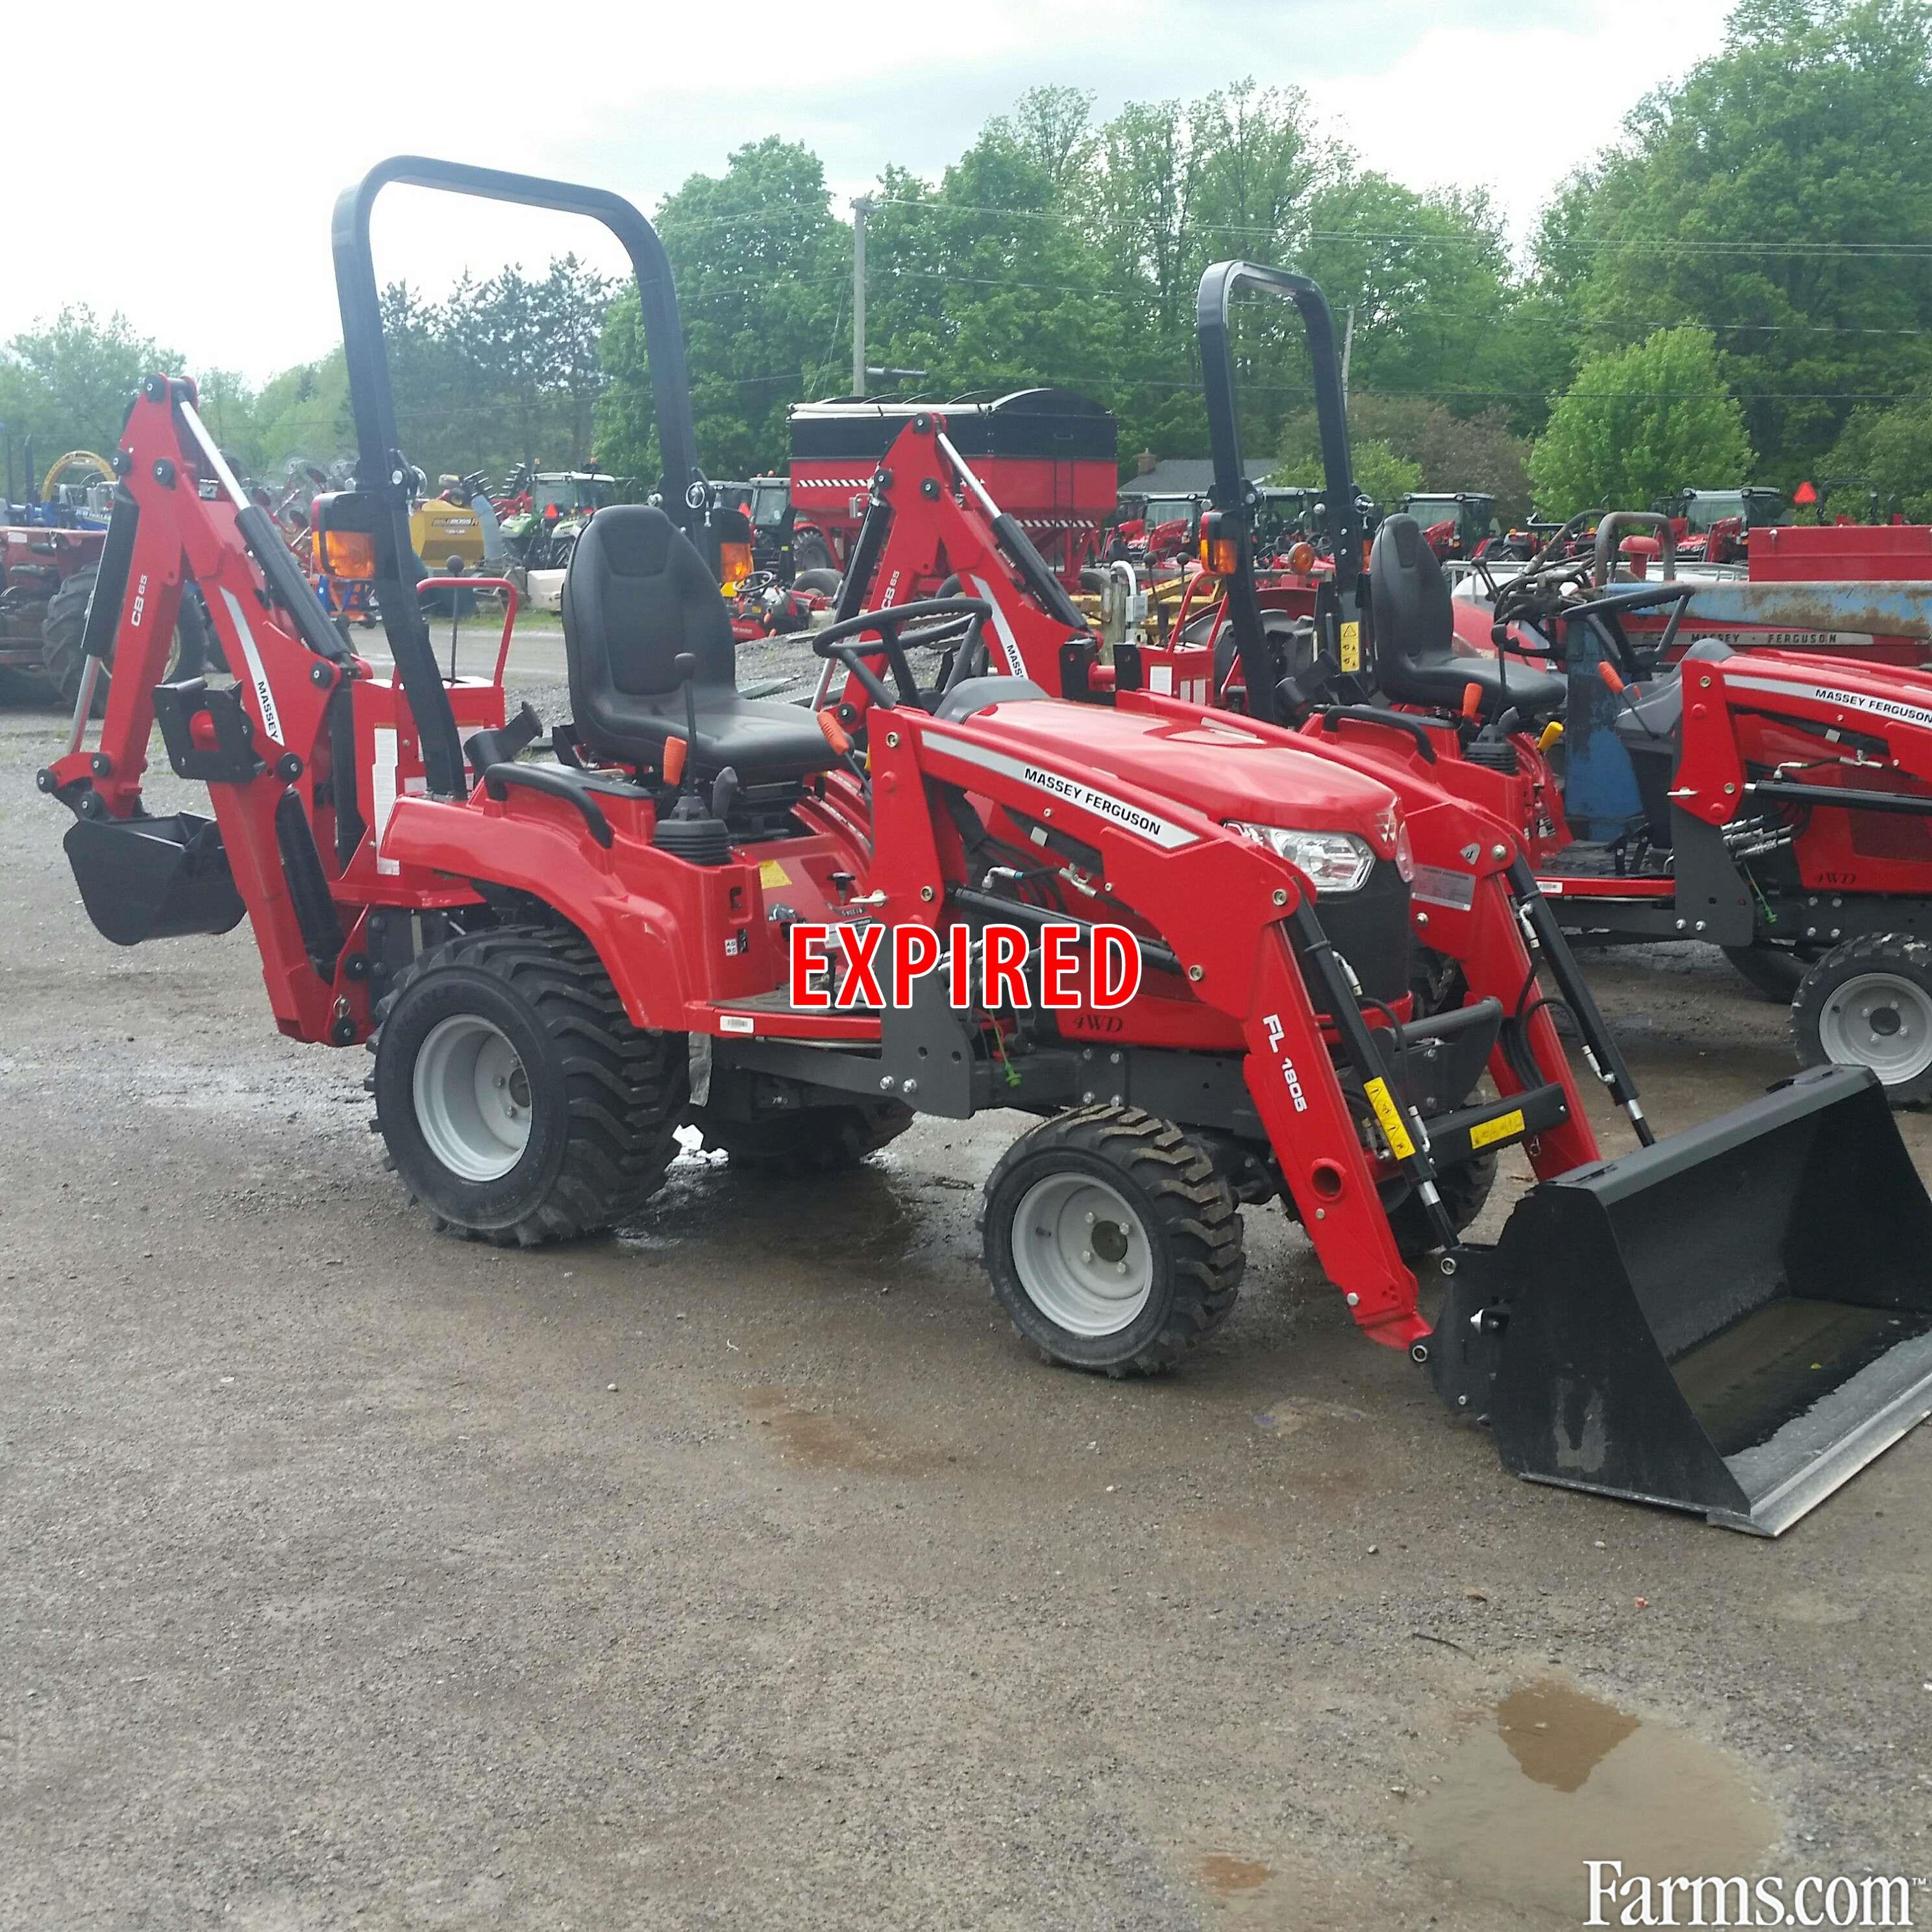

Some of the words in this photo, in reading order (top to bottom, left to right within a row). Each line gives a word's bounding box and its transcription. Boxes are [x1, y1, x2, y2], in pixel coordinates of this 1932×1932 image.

[131, 596, 145, 626] CB
[138, 574, 148, 595] 65
[881, 587, 895, 609] CB
[890, 571, 900, 587] 65
[1768, 634, 1837, 643] FERGUSON
[1006, 644, 1024, 678] MASS
[258, 681, 279, 739] MASSEY
[1815, 689, 1866, 706] MASSEY
[1868, 700, 1932, 723] FERGUSON
[1024, 768, 1082, 799] MASSEY
[1085, 793, 1161, 836] FERGUSON
[1072, 1013, 1123, 1033] 4WD
[1263, 1014, 1285, 1054] FL
[1282, 1057, 1308, 1113] 1805
